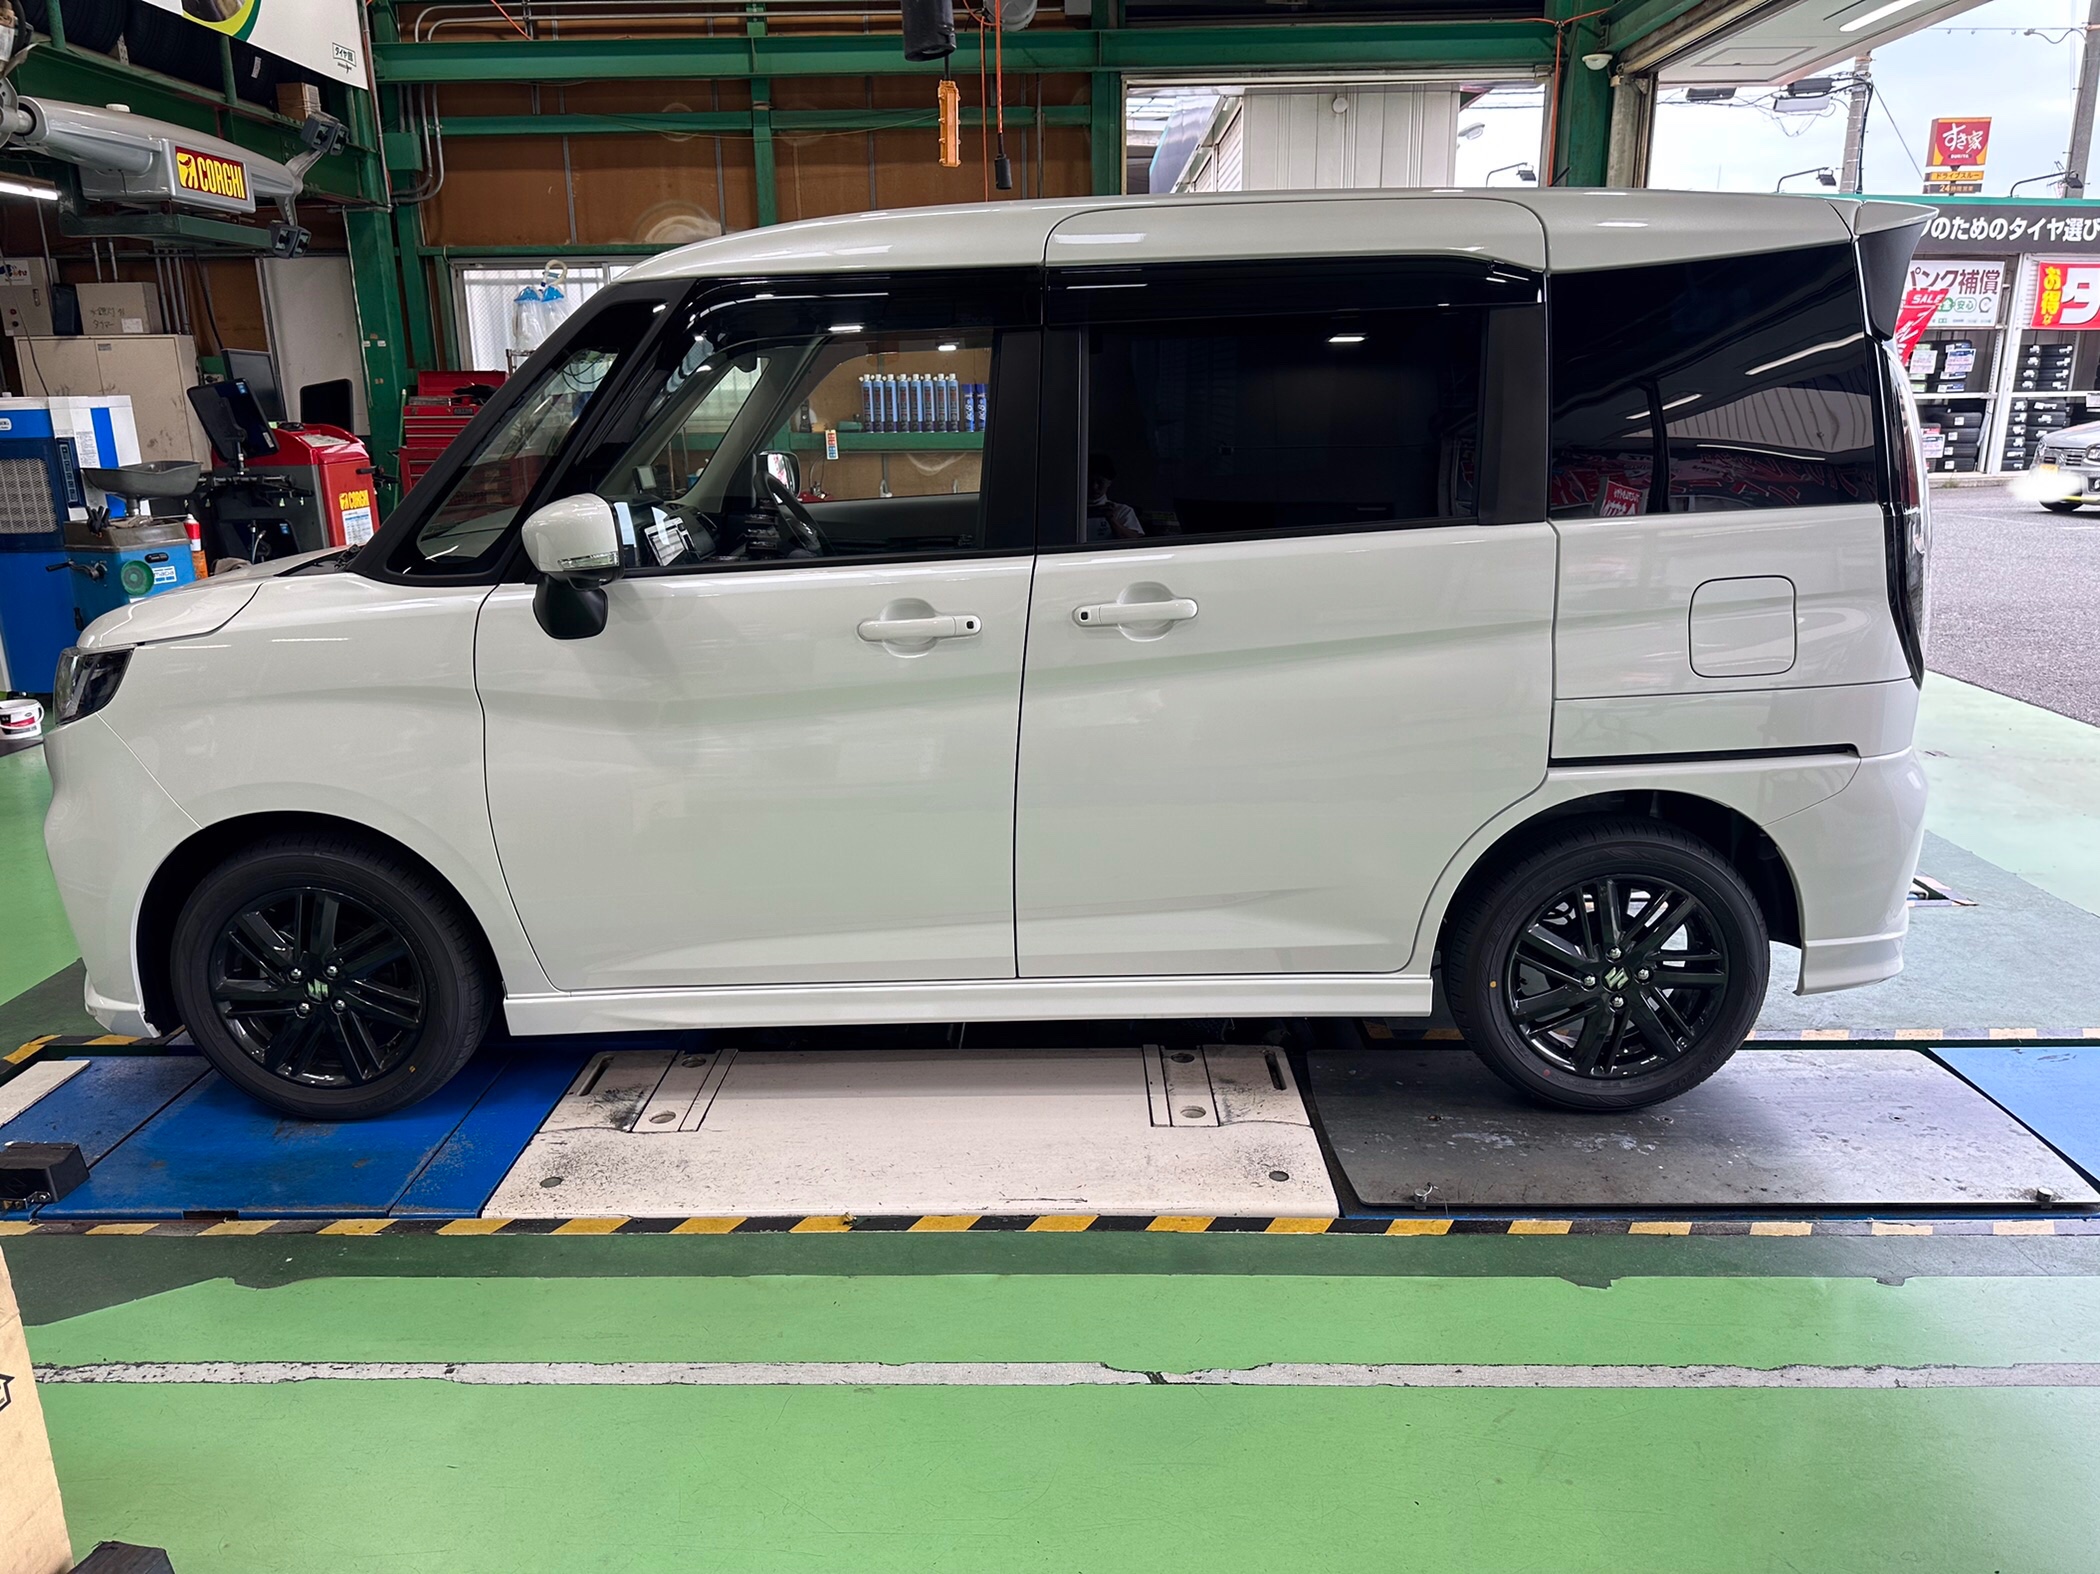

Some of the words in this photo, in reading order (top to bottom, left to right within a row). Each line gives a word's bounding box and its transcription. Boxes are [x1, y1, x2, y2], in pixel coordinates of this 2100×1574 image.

[1942, 122, 1984, 154] すき家
[196, 156, 246, 199] CORGHI
[1936, 172, 1980, 180] ドライブスルー
[1921, 215, 2100, 242] のためのタイヤ選び
[1910, 266, 2001, 295] パンク補償
[1911, 294, 1945, 304] SALE
[1957, 300, 1975, 310] 安心
[2041, 266, 2061, 326] お得な
